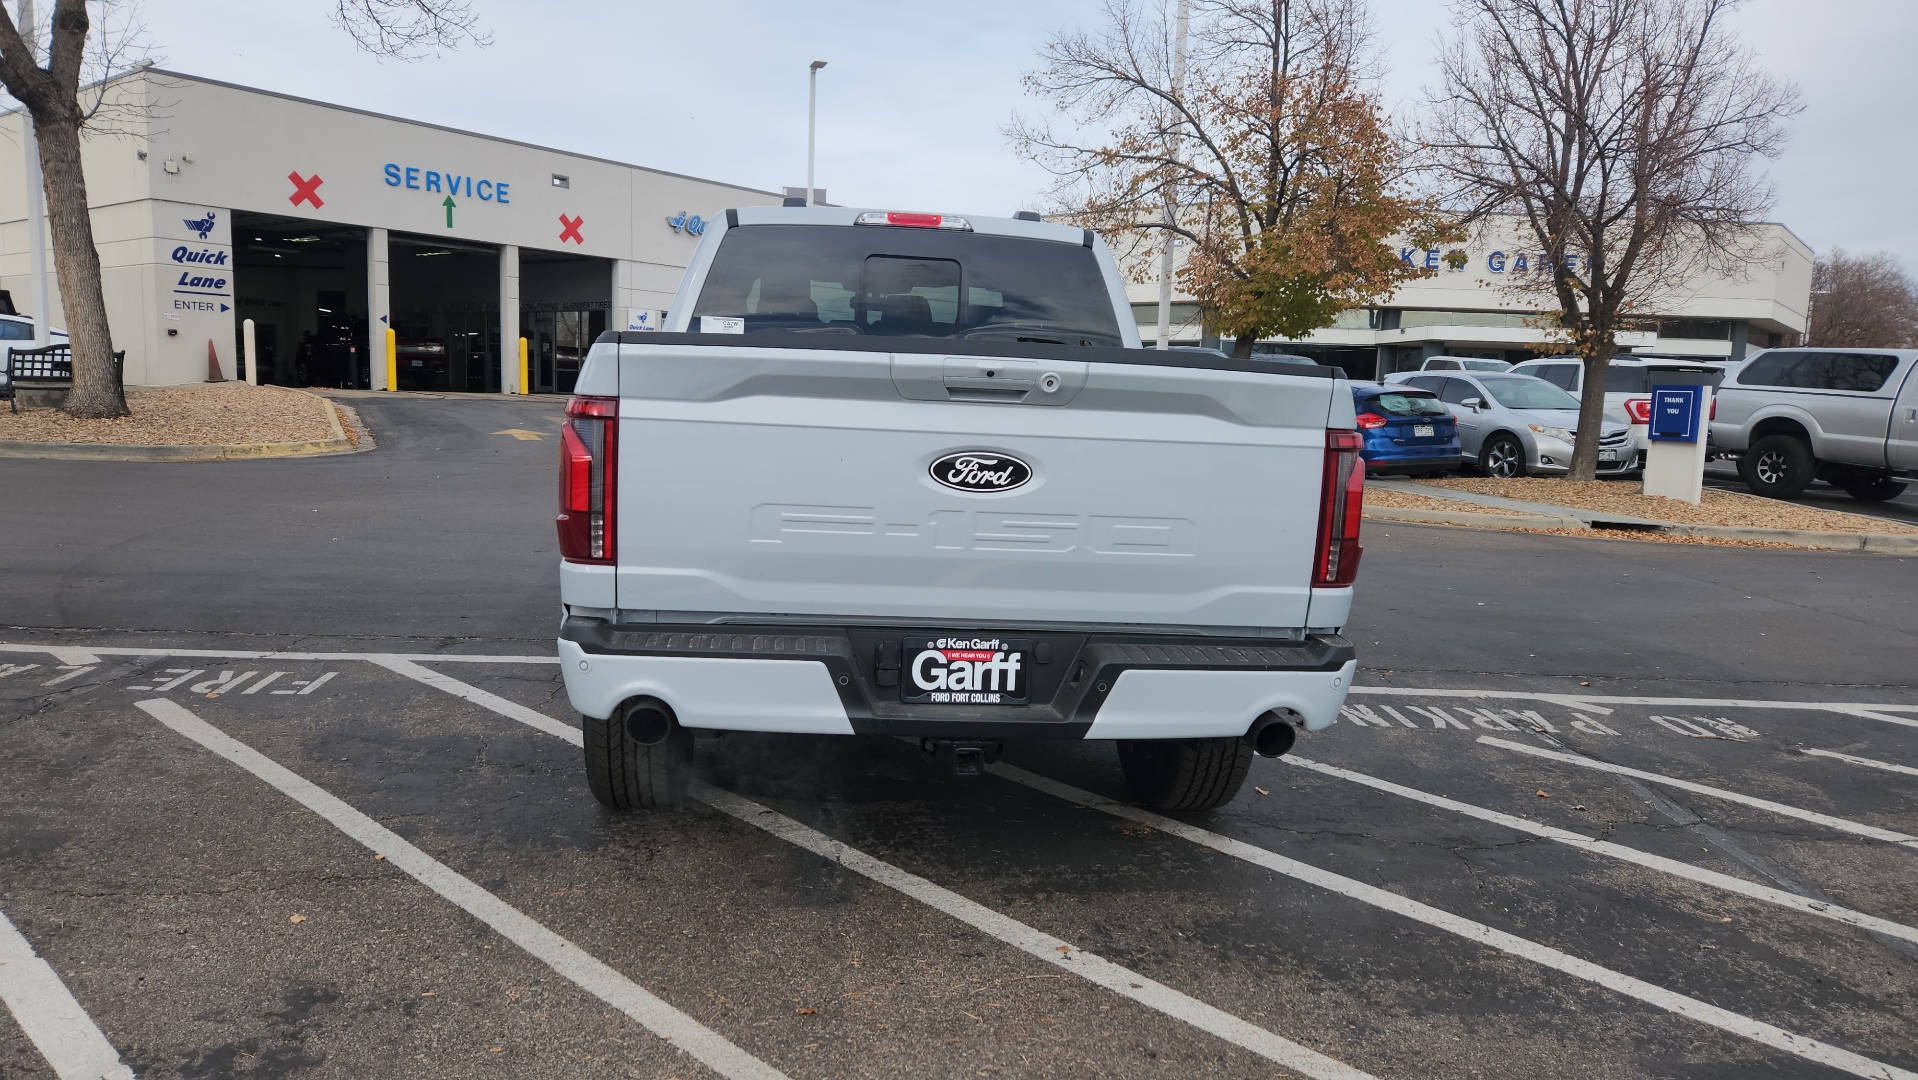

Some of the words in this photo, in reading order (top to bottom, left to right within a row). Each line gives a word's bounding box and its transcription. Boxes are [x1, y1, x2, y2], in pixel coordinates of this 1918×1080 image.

[384, 163, 510, 204] SERVICE
[172, 246, 228, 265] Quick
[1488, 251, 1592, 275] GARF
[177, 271, 226, 289] Lane
[174, 300, 215, 311] ENTER
[562, 301, 596, 309] ALIGNMENT
[596, 300, 612, 309] TIRES
[947, 456, 1014, 486] Ford
[750, 503, 1197, 556] F-150
[947, 638, 970, 649] Ken
[971, 639, 1000, 650] Garff
[126, 668, 339, 695] FIRE
[911, 649, 1021, 691] Garff
[931, 693, 950, 702] FORD
[952, 693, 969, 703] FORT
[971, 693, 1001, 704] COLLINS
[1333, 704, 1622, 737] PARKIN
